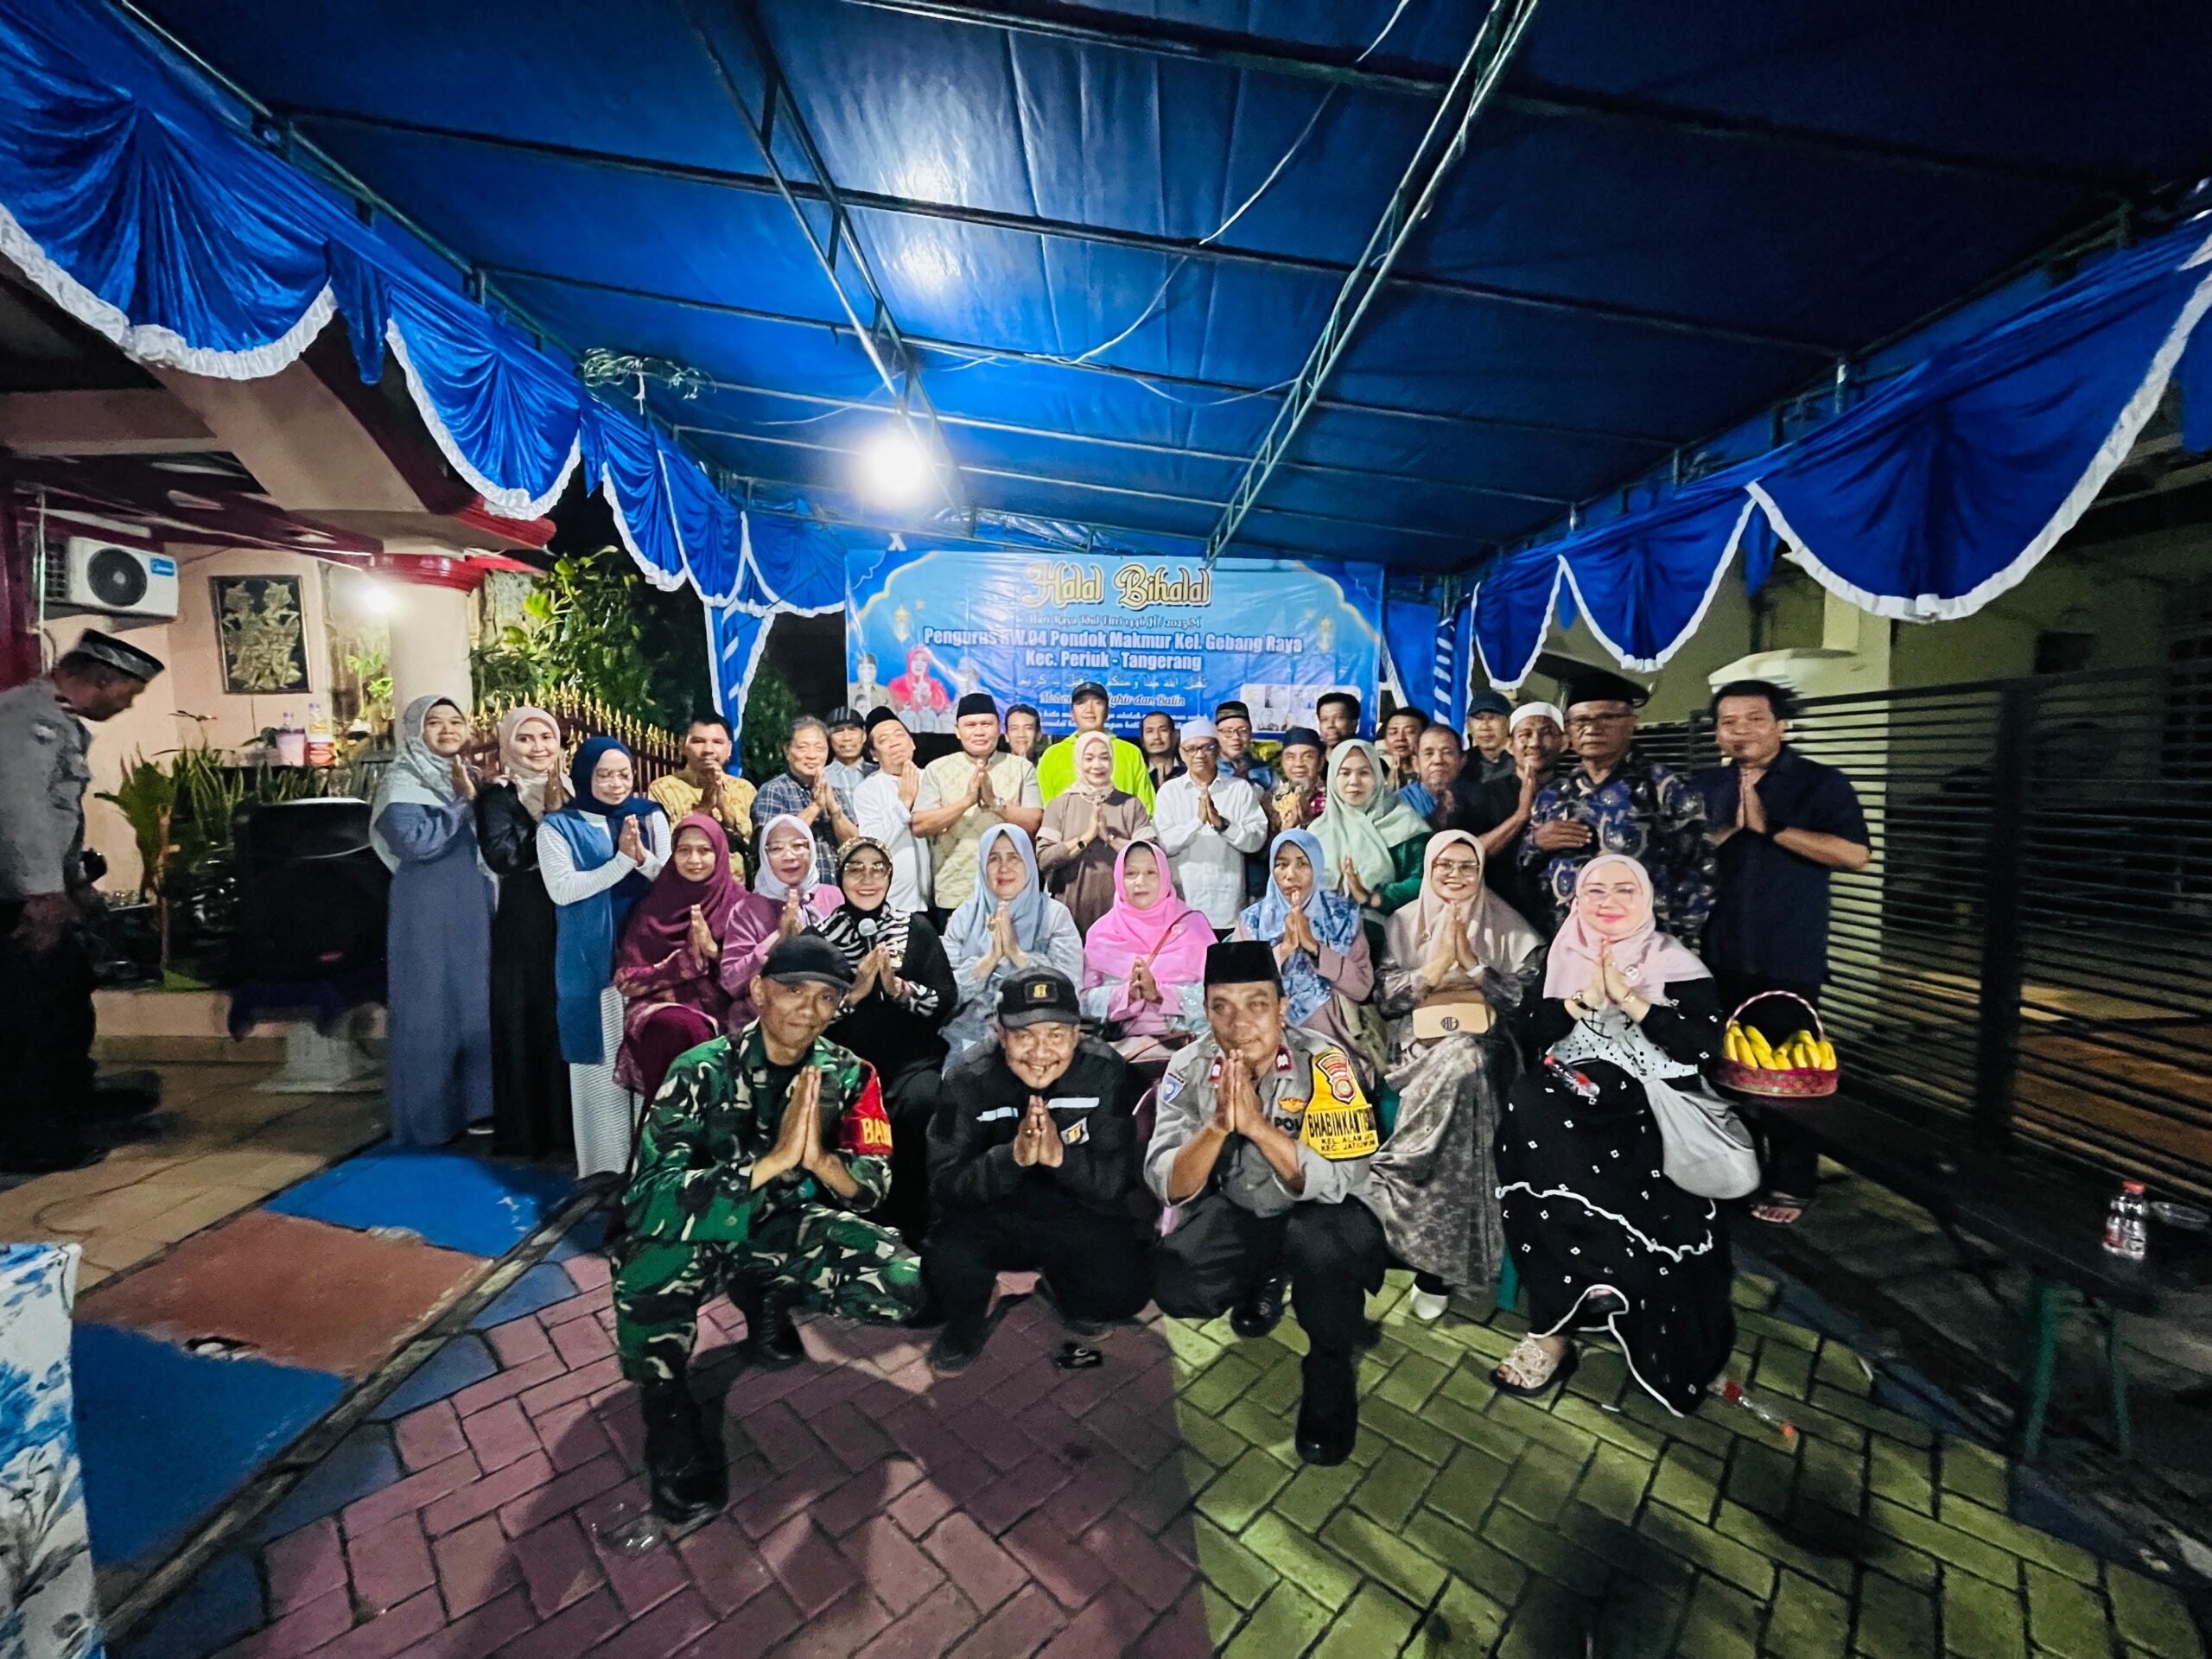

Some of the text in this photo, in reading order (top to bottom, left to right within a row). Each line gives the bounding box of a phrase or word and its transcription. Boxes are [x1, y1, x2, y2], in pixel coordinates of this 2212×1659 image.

[1021, 562, 1211, 612] Halal Bihalal
[1053, 613, 1077, 626] Raya
[923, 626, 1000, 646] Pengurus
[1049, 630, 1108, 649] Pondok
[1109, 631, 1173, 650] Makmur
[1173, 632, 1204, 651] Kel.
[1205, 633, 1263, 654] Gebang
[1265, 634, 1304, 654] Raya
[1025, 649, 1058, 667] Kec.
[1060, 650, 1110, 669] Periuk
[1120, 652, 1203, 672] Tangerang
[1135, 694, 1155, 706] dan
[1155, 694, 1185, 707] Batin
